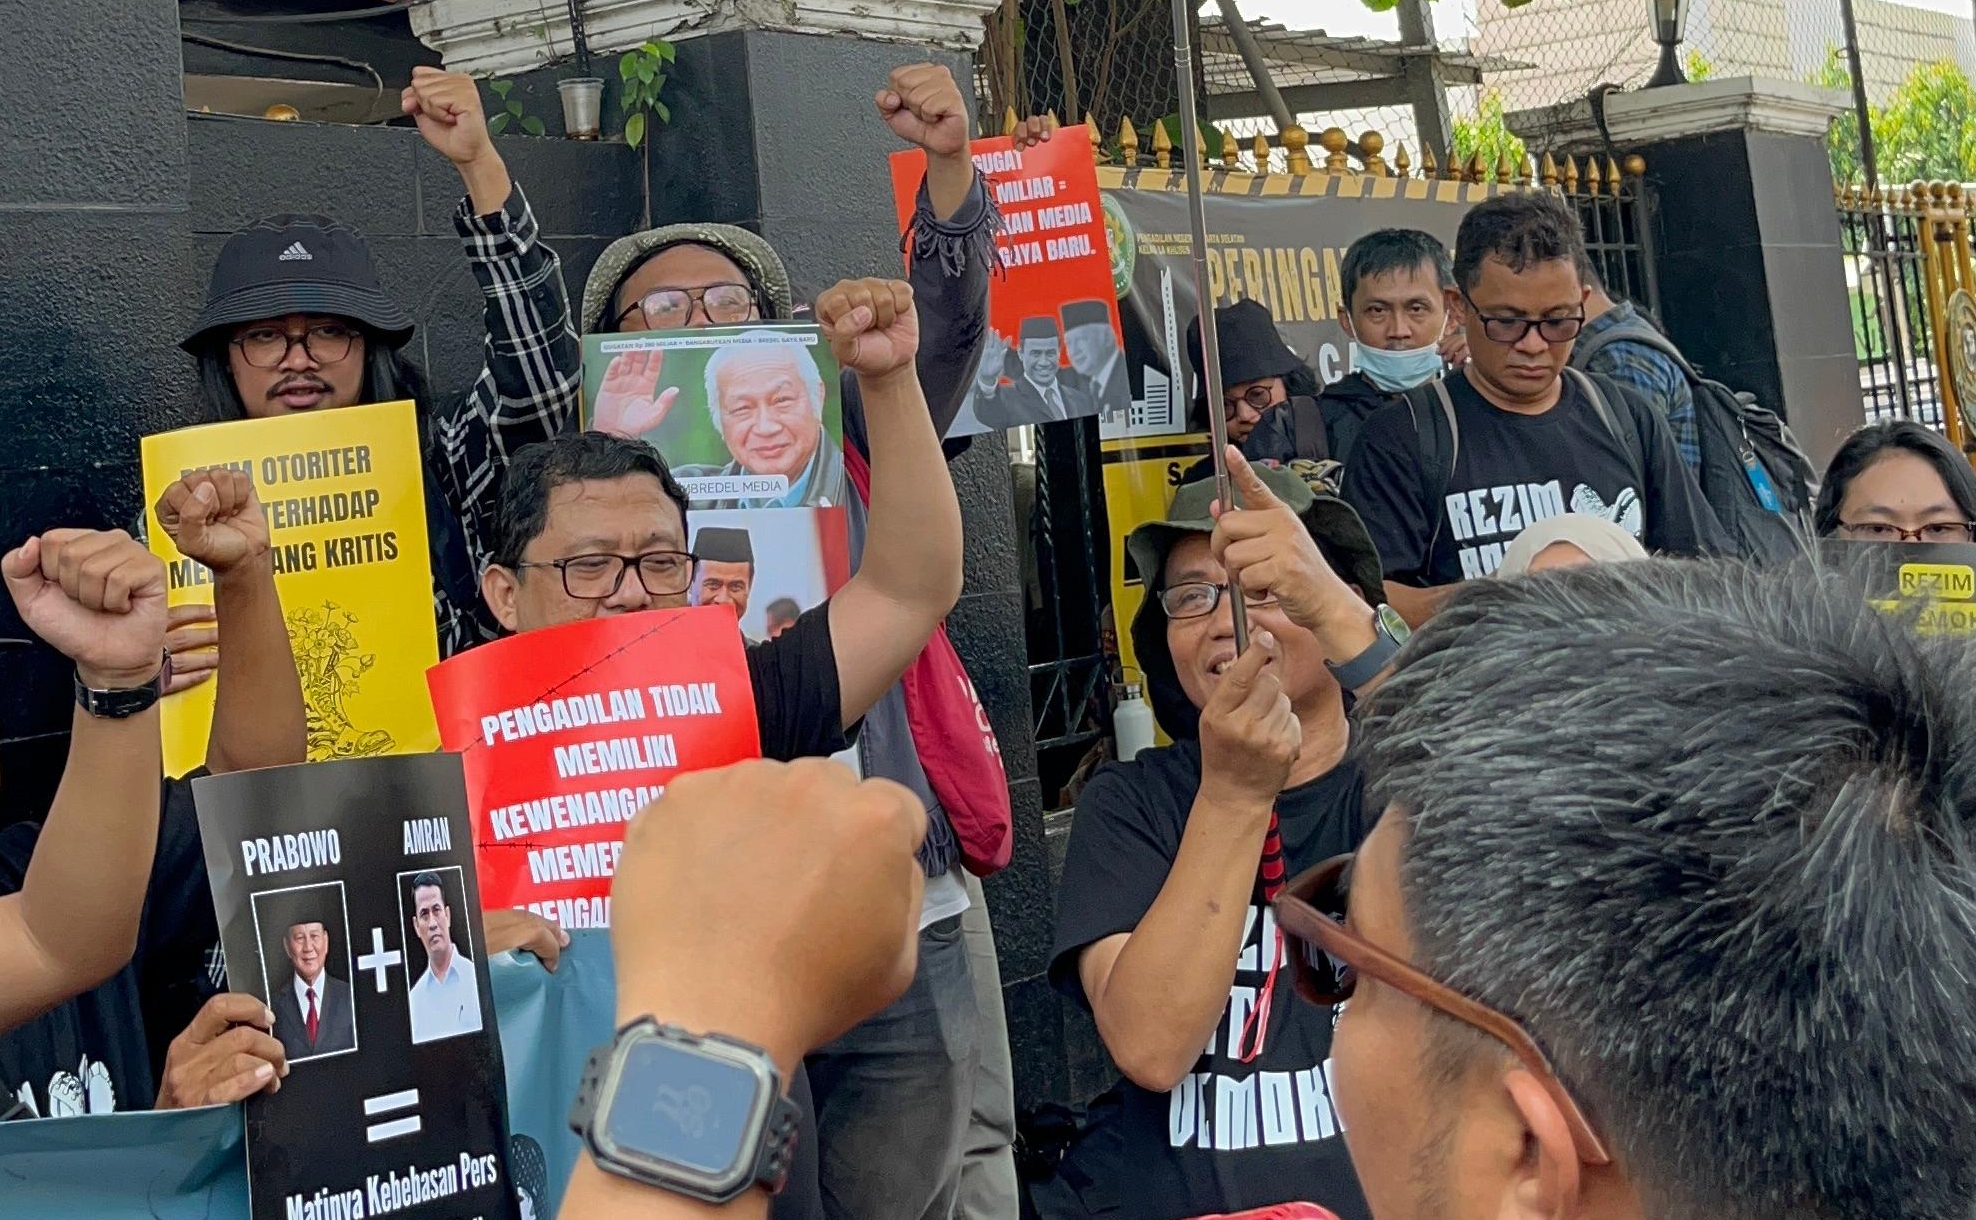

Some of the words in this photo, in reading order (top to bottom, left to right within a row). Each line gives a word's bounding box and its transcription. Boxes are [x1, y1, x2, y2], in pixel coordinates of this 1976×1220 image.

[972, 149, 1023, 174] GUGAT
[996, 175, 1056, 205] MILIAR
[1037, 202, 1093, 231] MEDIA
[998, 241, 1044, 268] GAYA
[1045, 233, 1097, 262] BARU.
[1205, 247, 1348, 321] PERINGA
[261, 445, 372, 486] OTORITER
[742, 480, 783, 493] MEDIA
[1445, 479, 1567, 541] REZIM
[271, 541, 318, 576] ANG
[324, 531, 399, 569] KRITIS
[1902, 571, 1972, 592] REZIM
[481, 687, 646, 747] PENGADILAN
[648, 682, 723, 718] TIDAK
[553, 733, 678, 779] MEMILIKI
[241, 828, 341, 876] PRABOWO
[403, 816, 452, 856] AMRAN
[1169, 1056, 1347, 1151] DEMOK
[286, 1186, 364, 1220] Matinya
[366, 1164, 459, 1216] Kebebasan
[459, 1152, 498, 1191] Pers
